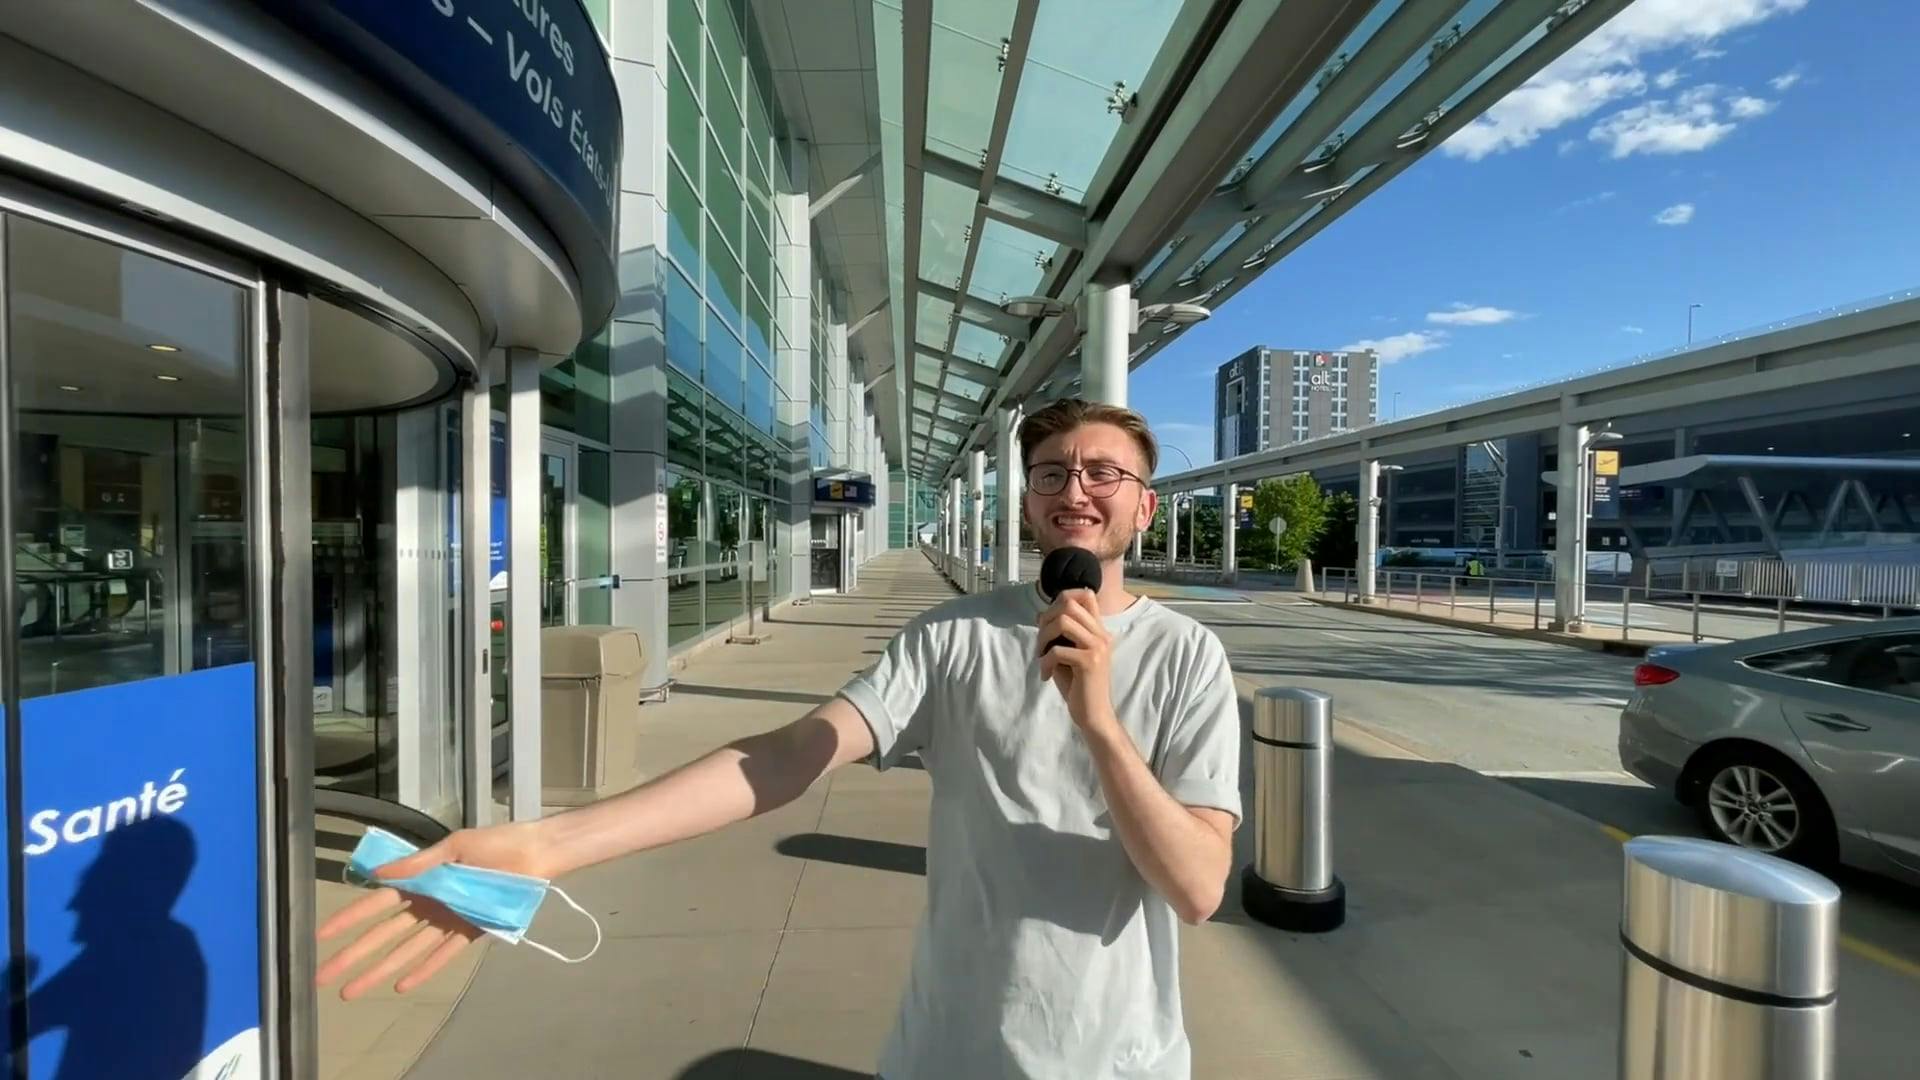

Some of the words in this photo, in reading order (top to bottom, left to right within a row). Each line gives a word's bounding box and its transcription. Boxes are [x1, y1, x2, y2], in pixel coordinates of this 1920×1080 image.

[507, 30, 563, 129] Vols
[513, 0, 575, 77] ures
[1311, 370, 1331, 386] alt
[23, 767, 189, 856] Santé
